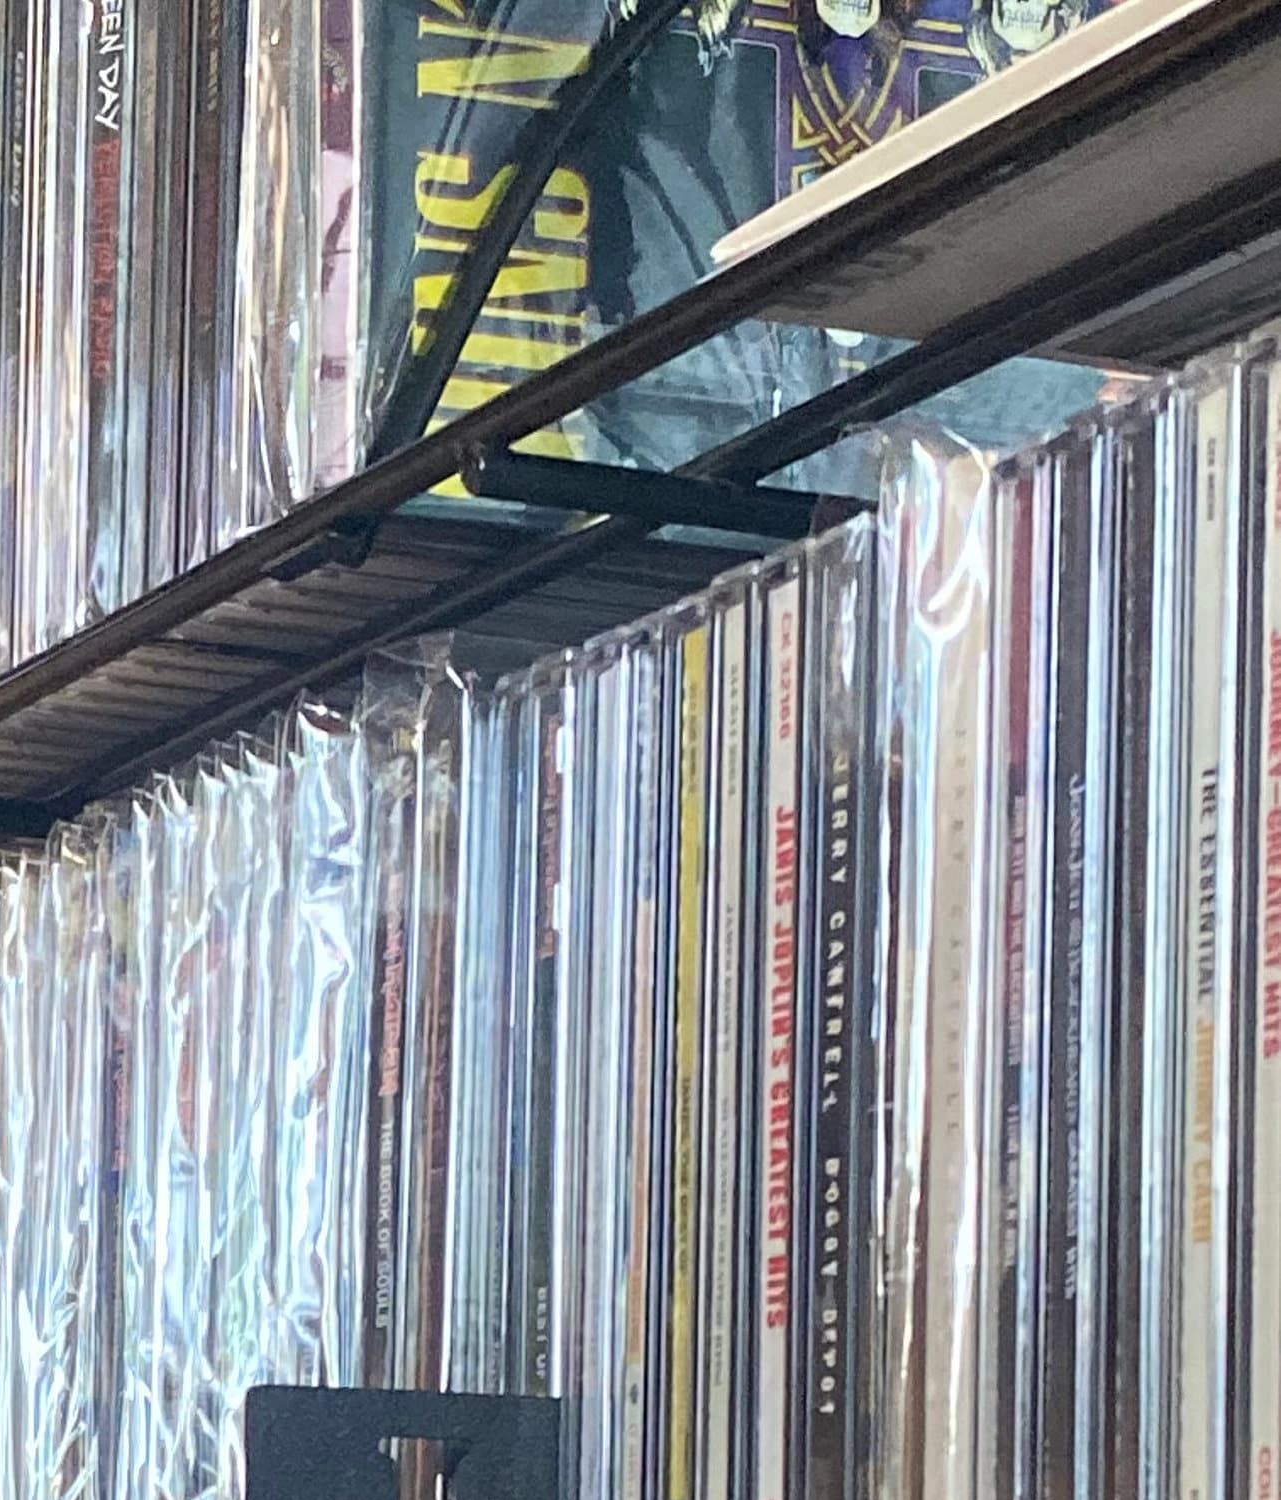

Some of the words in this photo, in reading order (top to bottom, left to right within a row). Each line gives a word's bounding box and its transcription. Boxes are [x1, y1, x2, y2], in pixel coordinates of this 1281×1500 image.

[95, 59, 121, 131] DAY
[828, 752, 850, 884] JERRY
[1201, 765, 1220, 819] THE
[775, 806, 797, 906] JANIS
[1197, 833, 1218, 1001] ESSENTIAL
[770, 921, 796, 1068] JOPLIN'S
[822, 911, 847, 1114] CANTRELL
[767, 1080, 792, 1240] GREATEST
[1191, 1157, 1213, 1244] CASH
[765, 1254, 790, 1330] HITS
